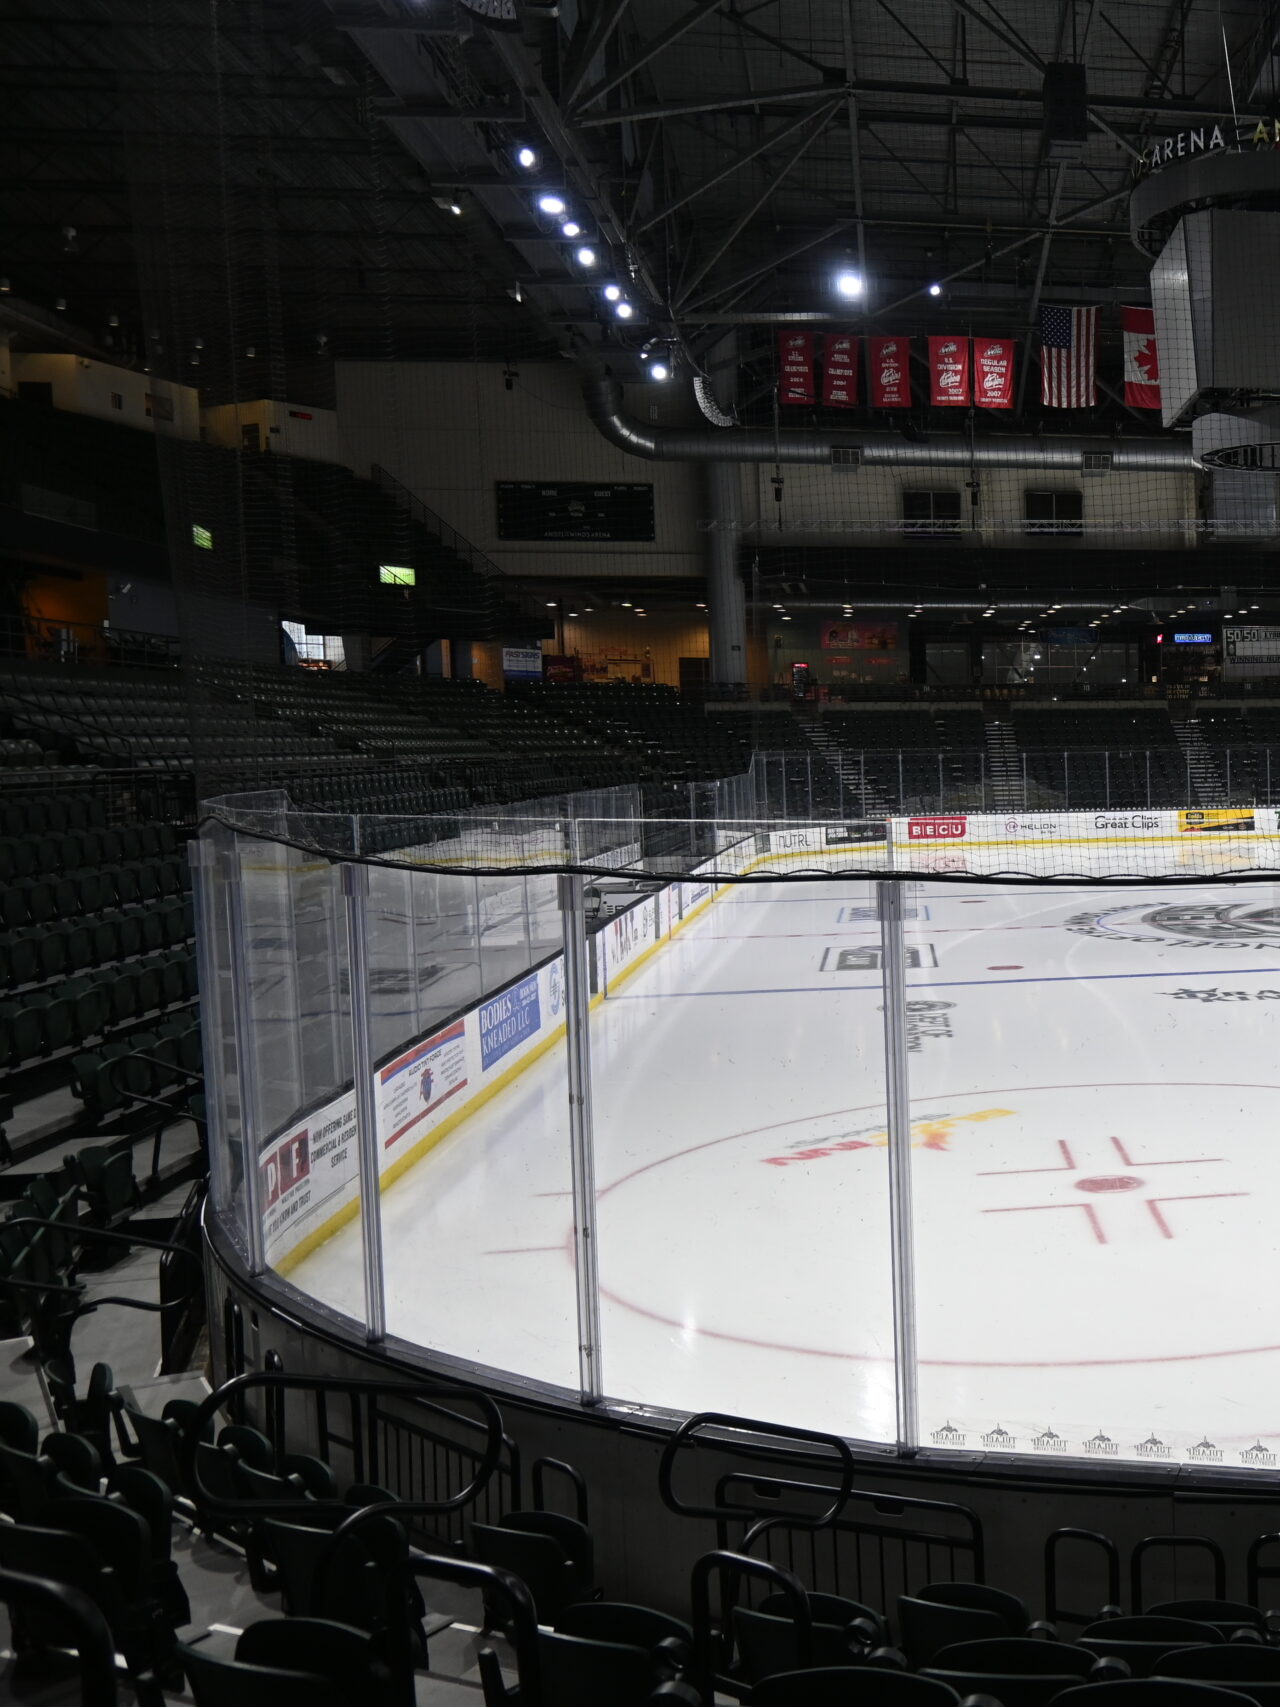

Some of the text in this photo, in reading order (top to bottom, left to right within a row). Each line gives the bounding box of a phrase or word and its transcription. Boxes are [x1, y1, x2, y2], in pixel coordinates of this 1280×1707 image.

[1152, 124, 1225, 167] ARENA
[980, 358, 1007, 366] REGULAR
[1095, 814, 1159, 830] Great Clips
[481, 994, 512, 1034] BODIES
[482, 1017, 516, 1056] KNEADED
[518, 1007, 530, 1031] LLC
[323, 1117, 342, 1139] OFFERING
[343, 1111, 353, 1126] SAME
[291, 1141, 300, 1178] F
[311, 1140, 337, 1164] COMMERCIAL
[341, 1125, 357, 1144] RESIDEN
[331, 1148, 348, 1168] SERVICE
[299, 1190, 311, 1209] TRUST
